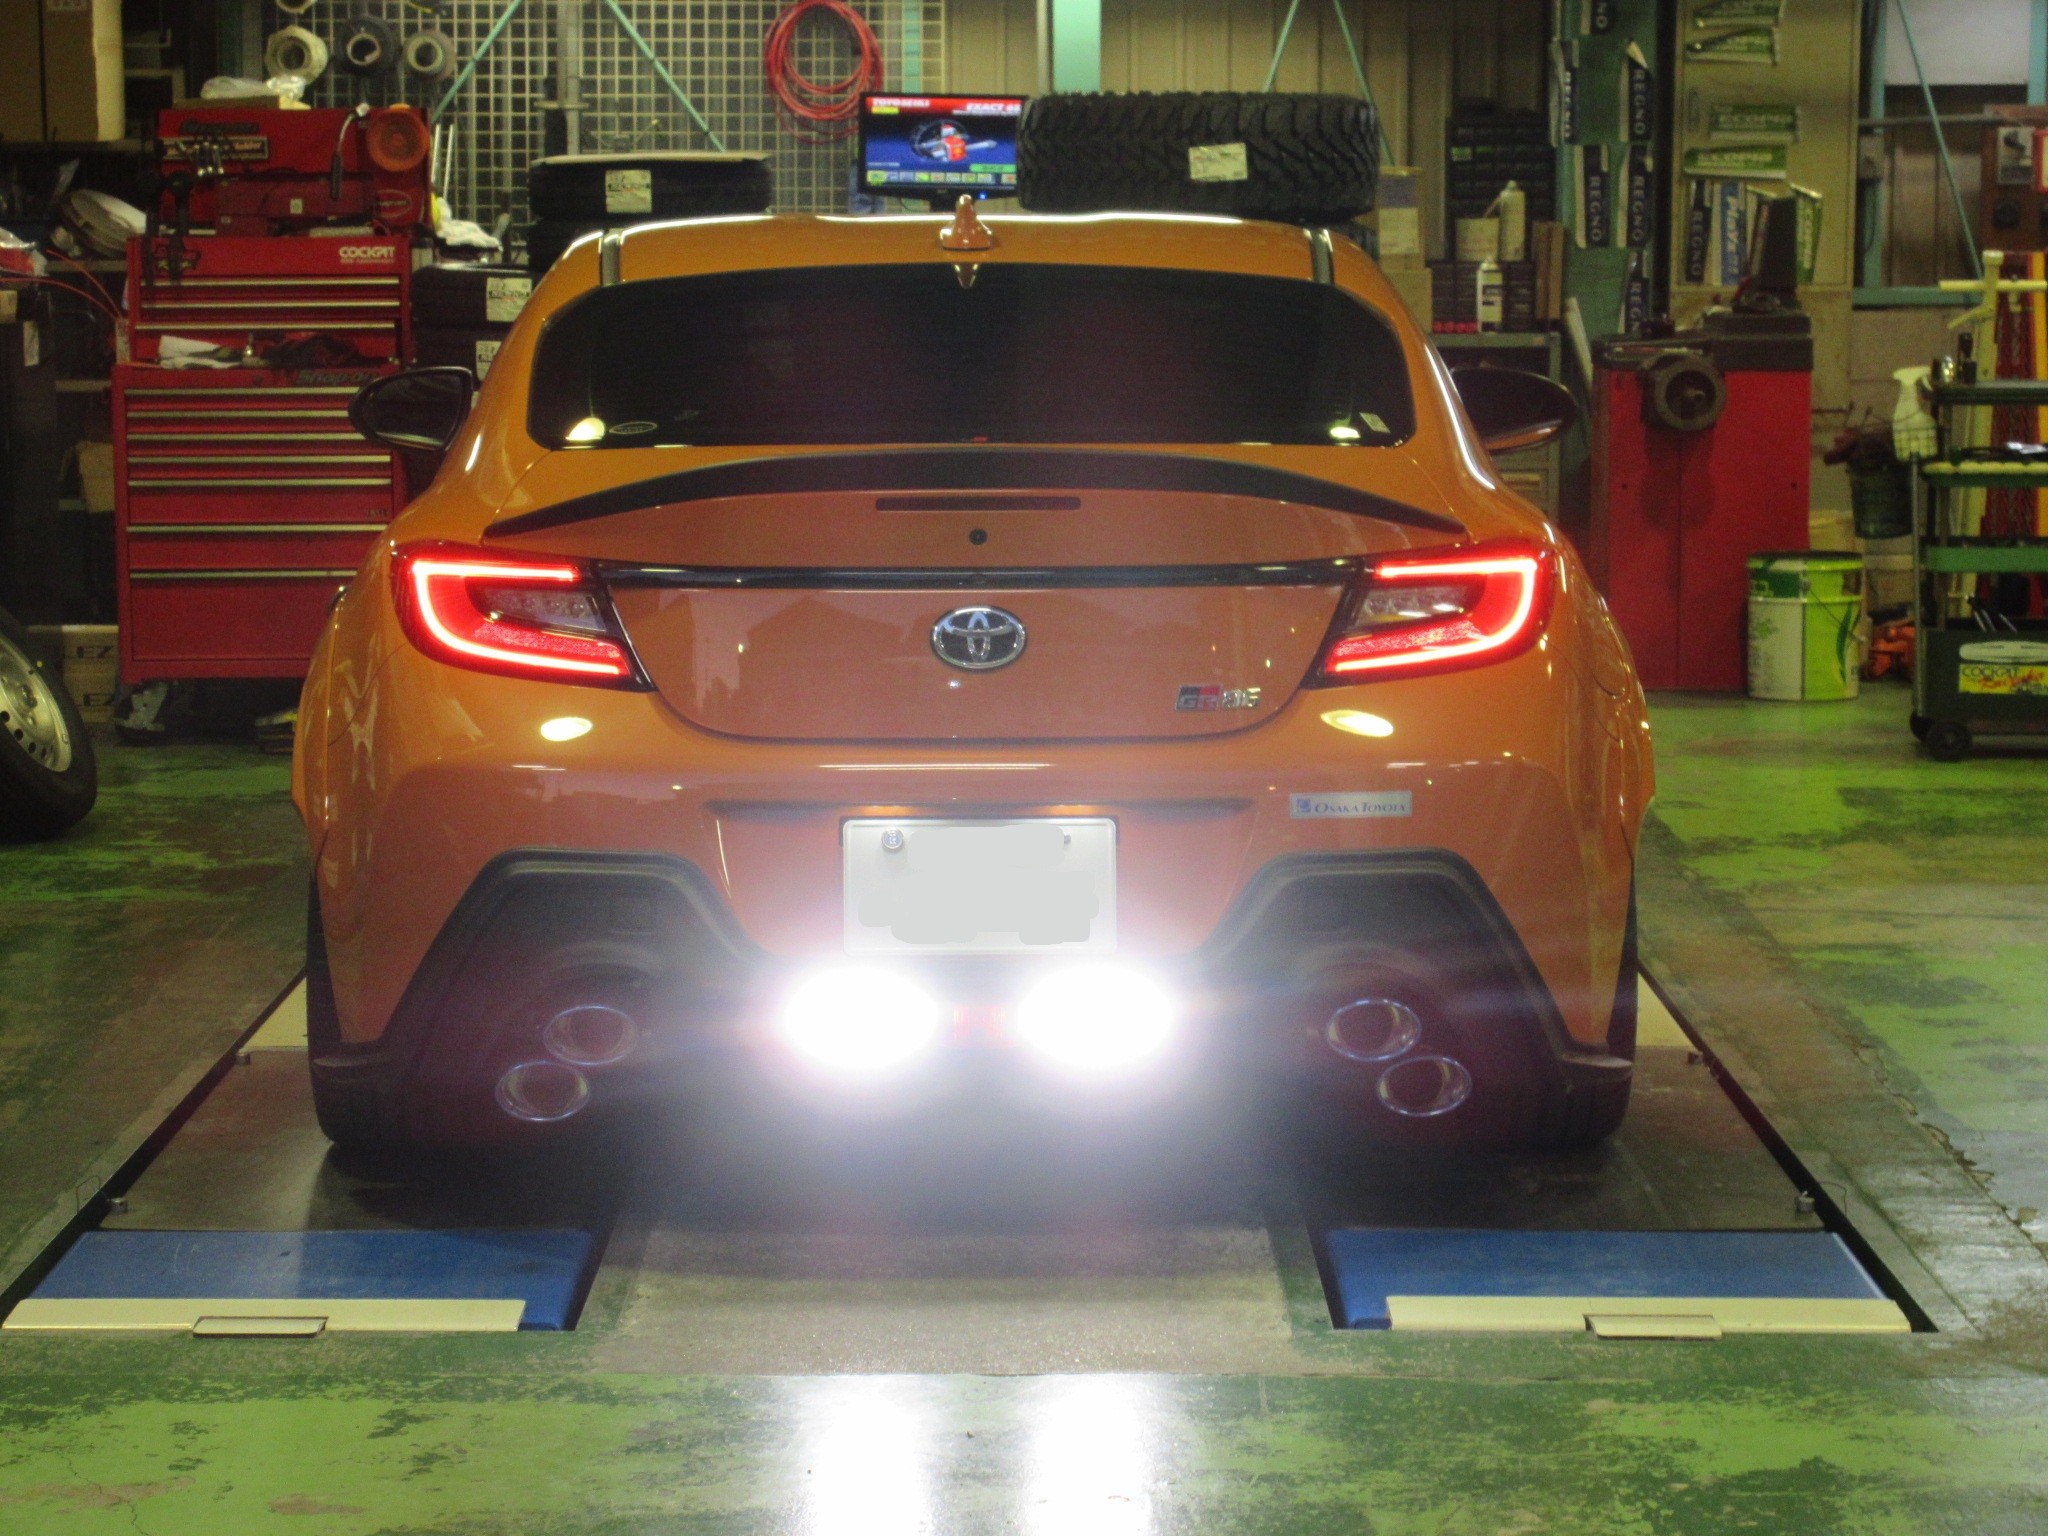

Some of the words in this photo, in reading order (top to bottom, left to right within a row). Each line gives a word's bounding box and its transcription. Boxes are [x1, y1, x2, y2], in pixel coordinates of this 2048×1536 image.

[1633, 69, 1646, 135] REGNO
[1588, 176, 1602, 242] REGNO
[1632, 176, 1645, 241] REGNO
[339, 246, 395, 258] COCKPIT
[1690, 210, 1704, 275] REGNO
